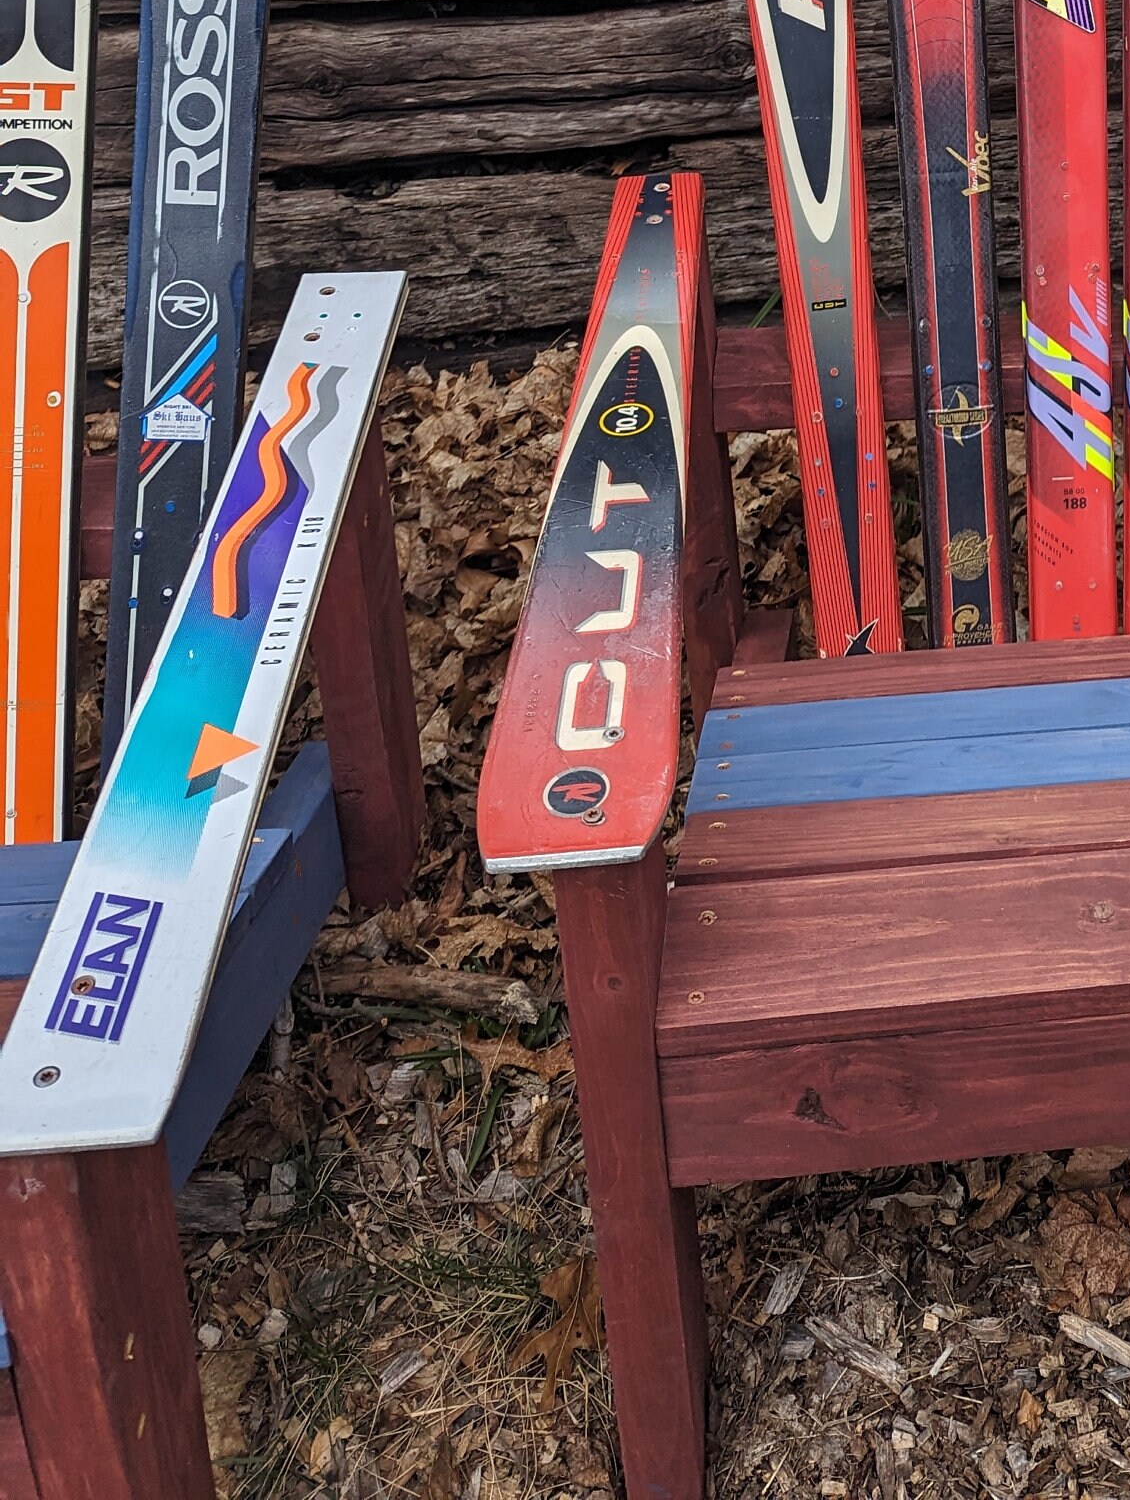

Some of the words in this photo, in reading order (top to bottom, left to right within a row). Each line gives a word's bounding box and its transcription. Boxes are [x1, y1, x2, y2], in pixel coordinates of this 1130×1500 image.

[153, 411, 171, 421] Ski
[615, 406, 639, 433] 10.4
[1063, 497, 1087, 509] 188
[260, 578, 306, 665] CERAMIC
[301, 517, 325, 533] 918
[554, 459, 651, 751] CUT
[59, 893, 151, 1039] ELAN
